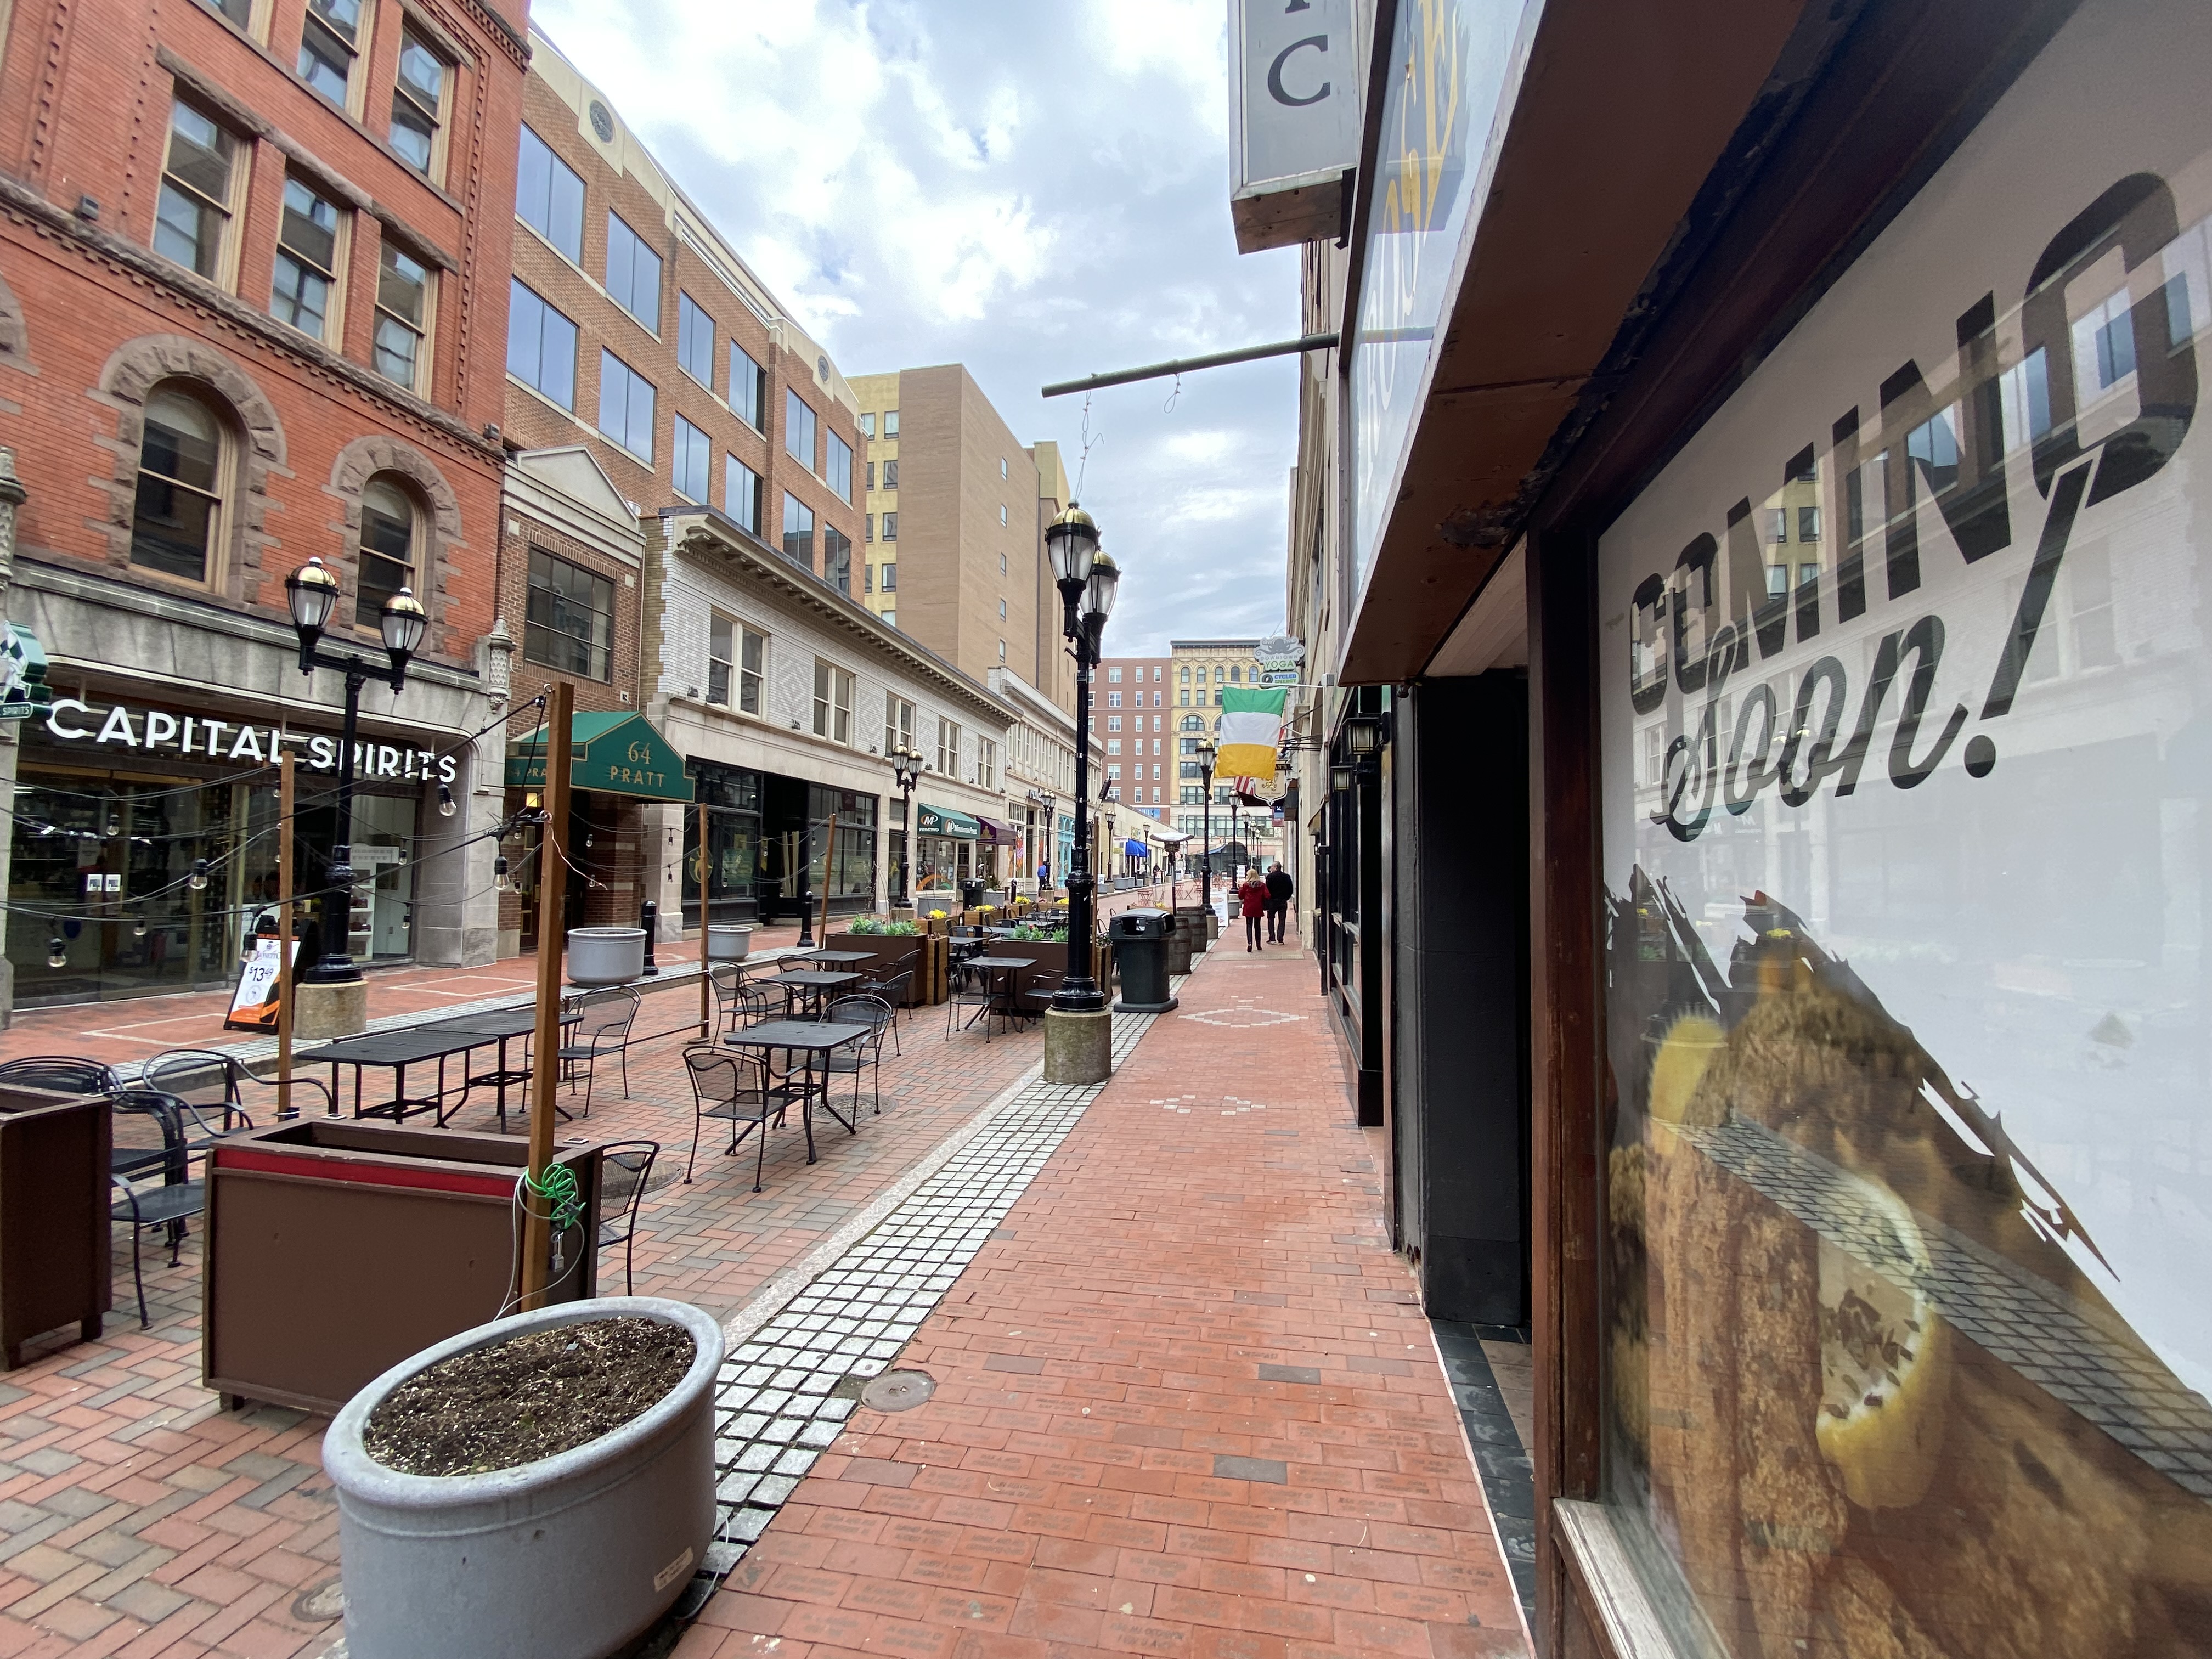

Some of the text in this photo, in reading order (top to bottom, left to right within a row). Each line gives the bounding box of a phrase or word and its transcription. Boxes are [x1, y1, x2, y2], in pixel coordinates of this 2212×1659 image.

[1268, 0, 1330, 106] C
[1630, 172, 2200, 715] COMING
[1265, 660, 1294, 668] YOGA
[2, 706, 30, 716] SPIRITS
[46, 698, 457, 783] CAPITAL SPIRITS
[628, 741, 651, 764] 64
[526, 768, 547, 777] PRA
[610, 765, 665, 787] PRATT
